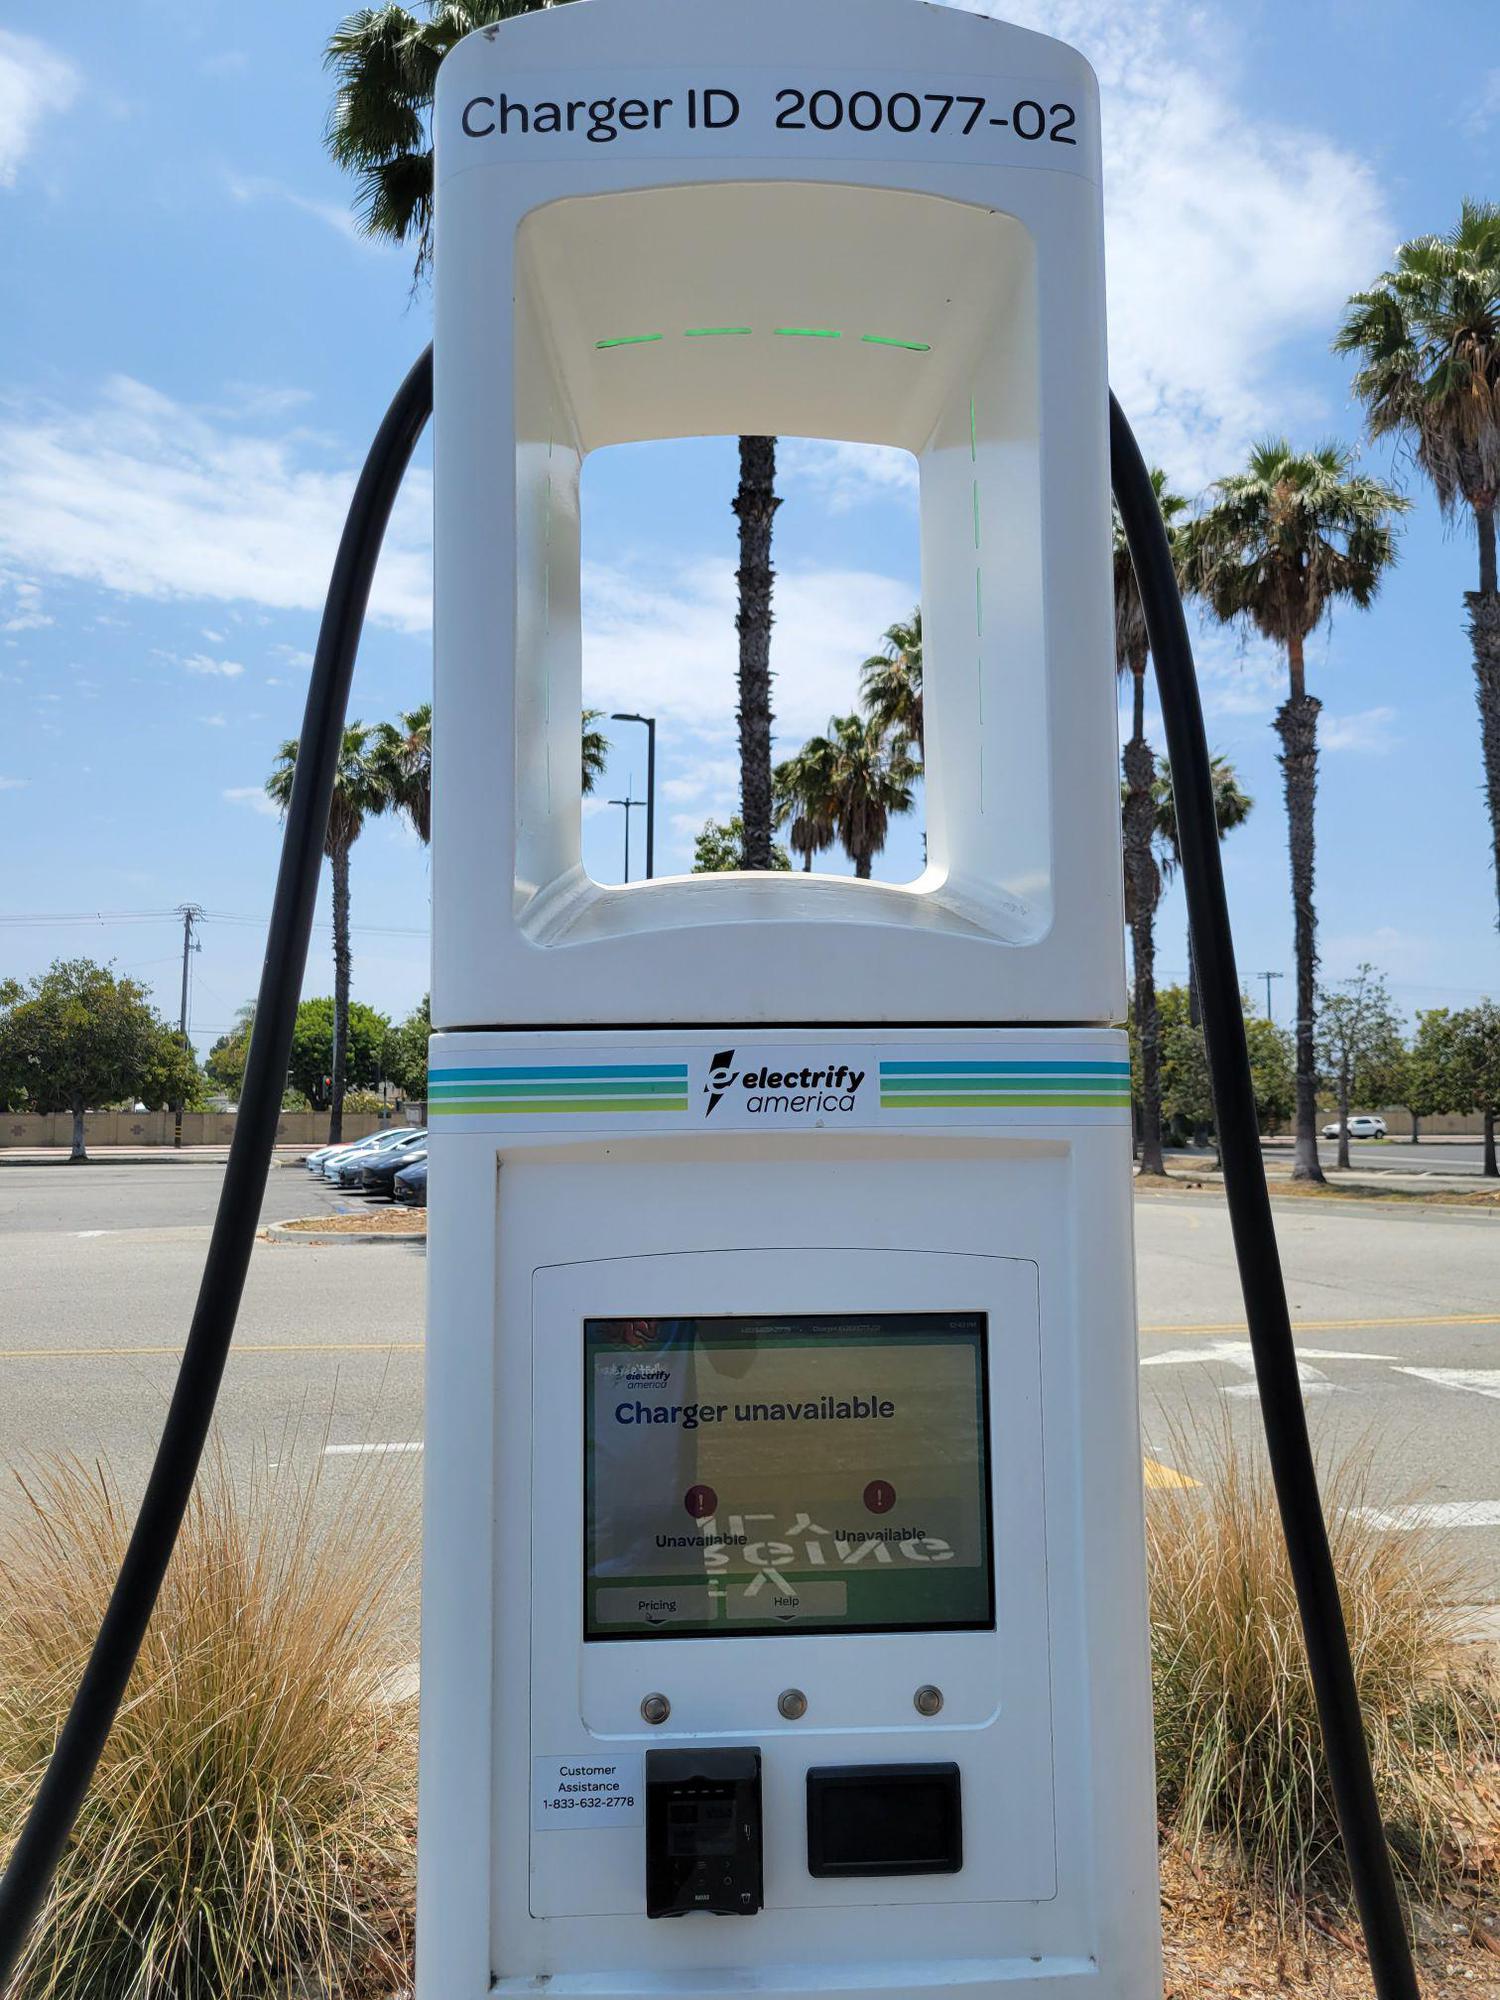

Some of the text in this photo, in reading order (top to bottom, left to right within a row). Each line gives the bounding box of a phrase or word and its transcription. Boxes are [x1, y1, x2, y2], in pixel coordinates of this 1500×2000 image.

[462, 88, 1078, 146] Charger ID 200077-02
[742, 1065, 865, 1093] electrify
[746, 1092, 856, 1113] america
[615, 1395, 896, 1430] Charger unavailable
[656, 1533, 748, 1549] Unavailable
[835, 1527, 927, 1544] Unavailable
[638, 1600, 677, 1613] Pricing
[774, 1597, 800, 1609] Help
[559, 1766, 617, 1777] Customer
[558, 1782, 620, 1793] Assistance
[543, 1796, 635, 1810] 1-833-632-2778
